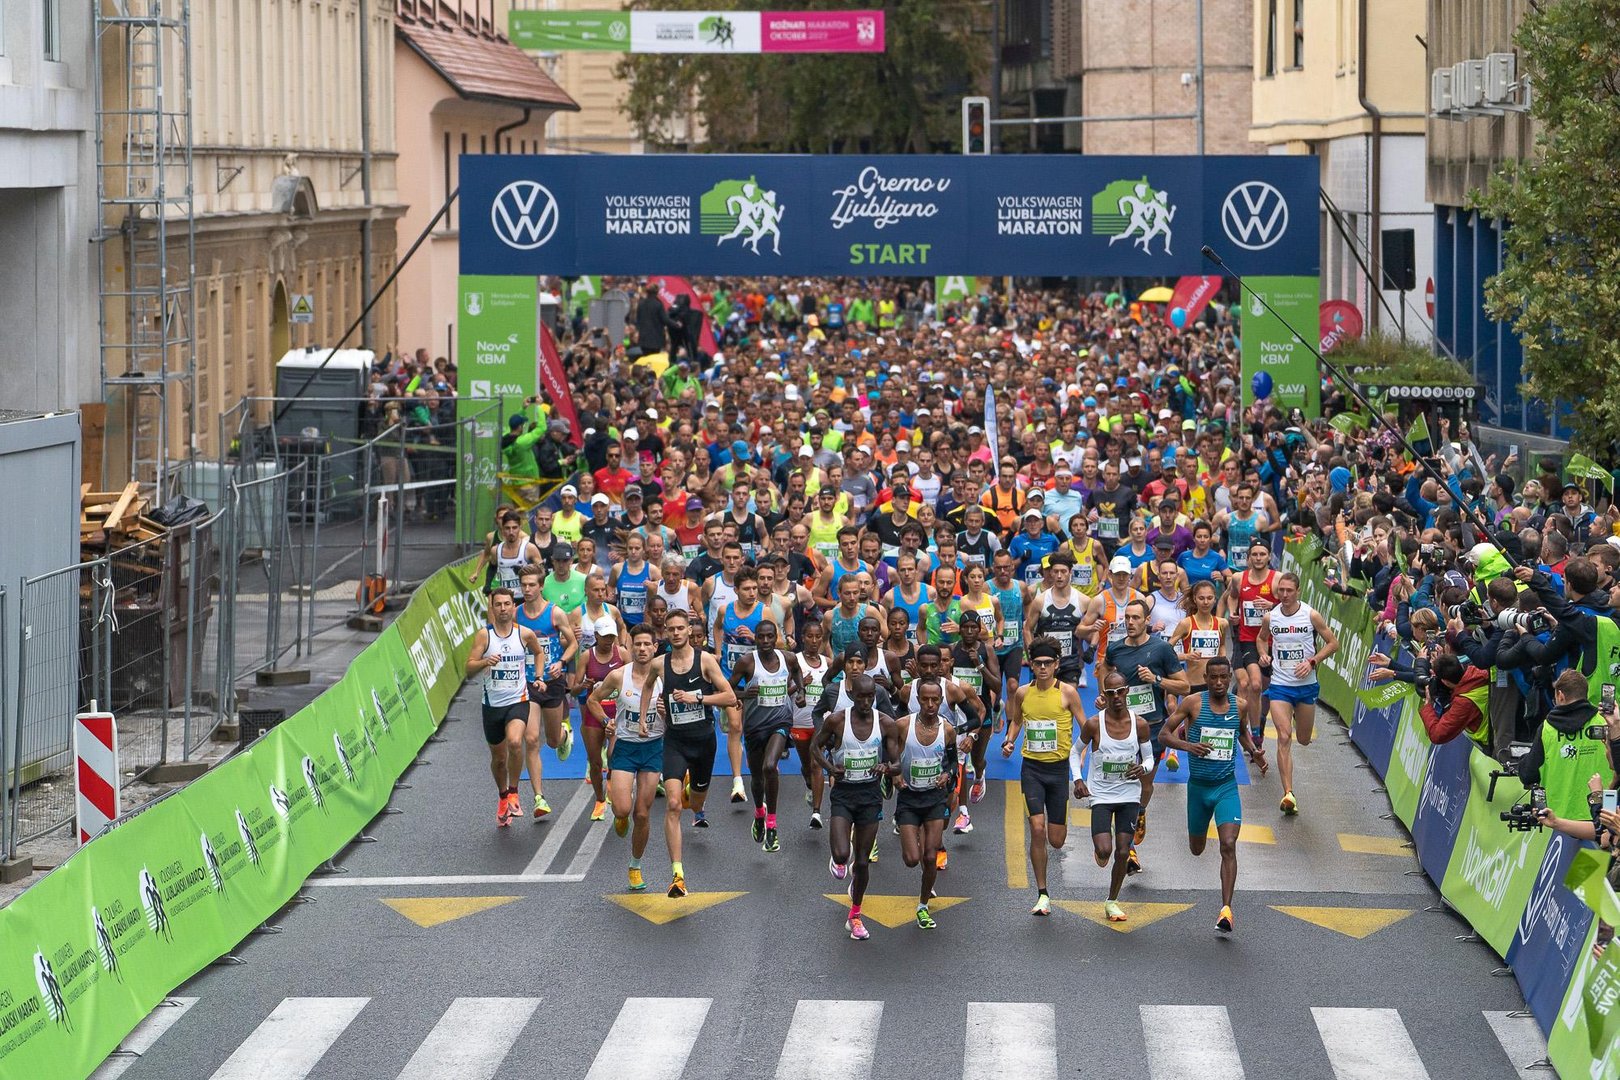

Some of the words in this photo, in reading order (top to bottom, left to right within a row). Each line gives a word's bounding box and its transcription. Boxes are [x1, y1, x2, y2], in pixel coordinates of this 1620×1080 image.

[770, 32, 806, 41] OKTOBER
[858, 166, 935, 199] Gremo
[937, 178, 951, 192] v
[605, 195, 690, 207] VOLKSWAGEN
[997, 196, 1082, 208] VOLKSWAGEN
[830, 185, 939, 229] Ljubljano
[606, 208, 690, 219] LJUBLJANSKI
[998, 208, 1082, 220] LJUBLJANSKI
[606, 220, 690, 234] MARATON
[998, 220, 1082, 235] MARATON
[849, 243, 931, 264] START
[476, 340, 510, 351] Nova
[1260, 341, 1294, 352] Nova
[476, 354, 507, 365] KBM
[1260, 354, 1290, 365] KBM
[494, 384, 523, 395] SAVA
[1278, 384, 1306, 394] SAVA
[1444, 388, 1452, 396] 11
[1455, 388, 1464, 397] 19
[1245, 608, 1250, 617] B
[1194, 639, 1200, 648] A
[1203, 638, 1219, 648] 2016
[731, 652, 736, 661] A
[1279, 651, 1284, 660] A
[1286, 651, 1303, 660] 2063
[493, 670, 499, 679] A
[502, 670, 519, 679] 2064
[763, 686, 785, 695] LEONARD
[1139, 693, 1152, 703] 990
[673, 704, 680, 713] A
[628, 712, 633, 721] A
[1035, 731, 1047, 739] ROK
[851, 758, 874, 769] EDMOND
